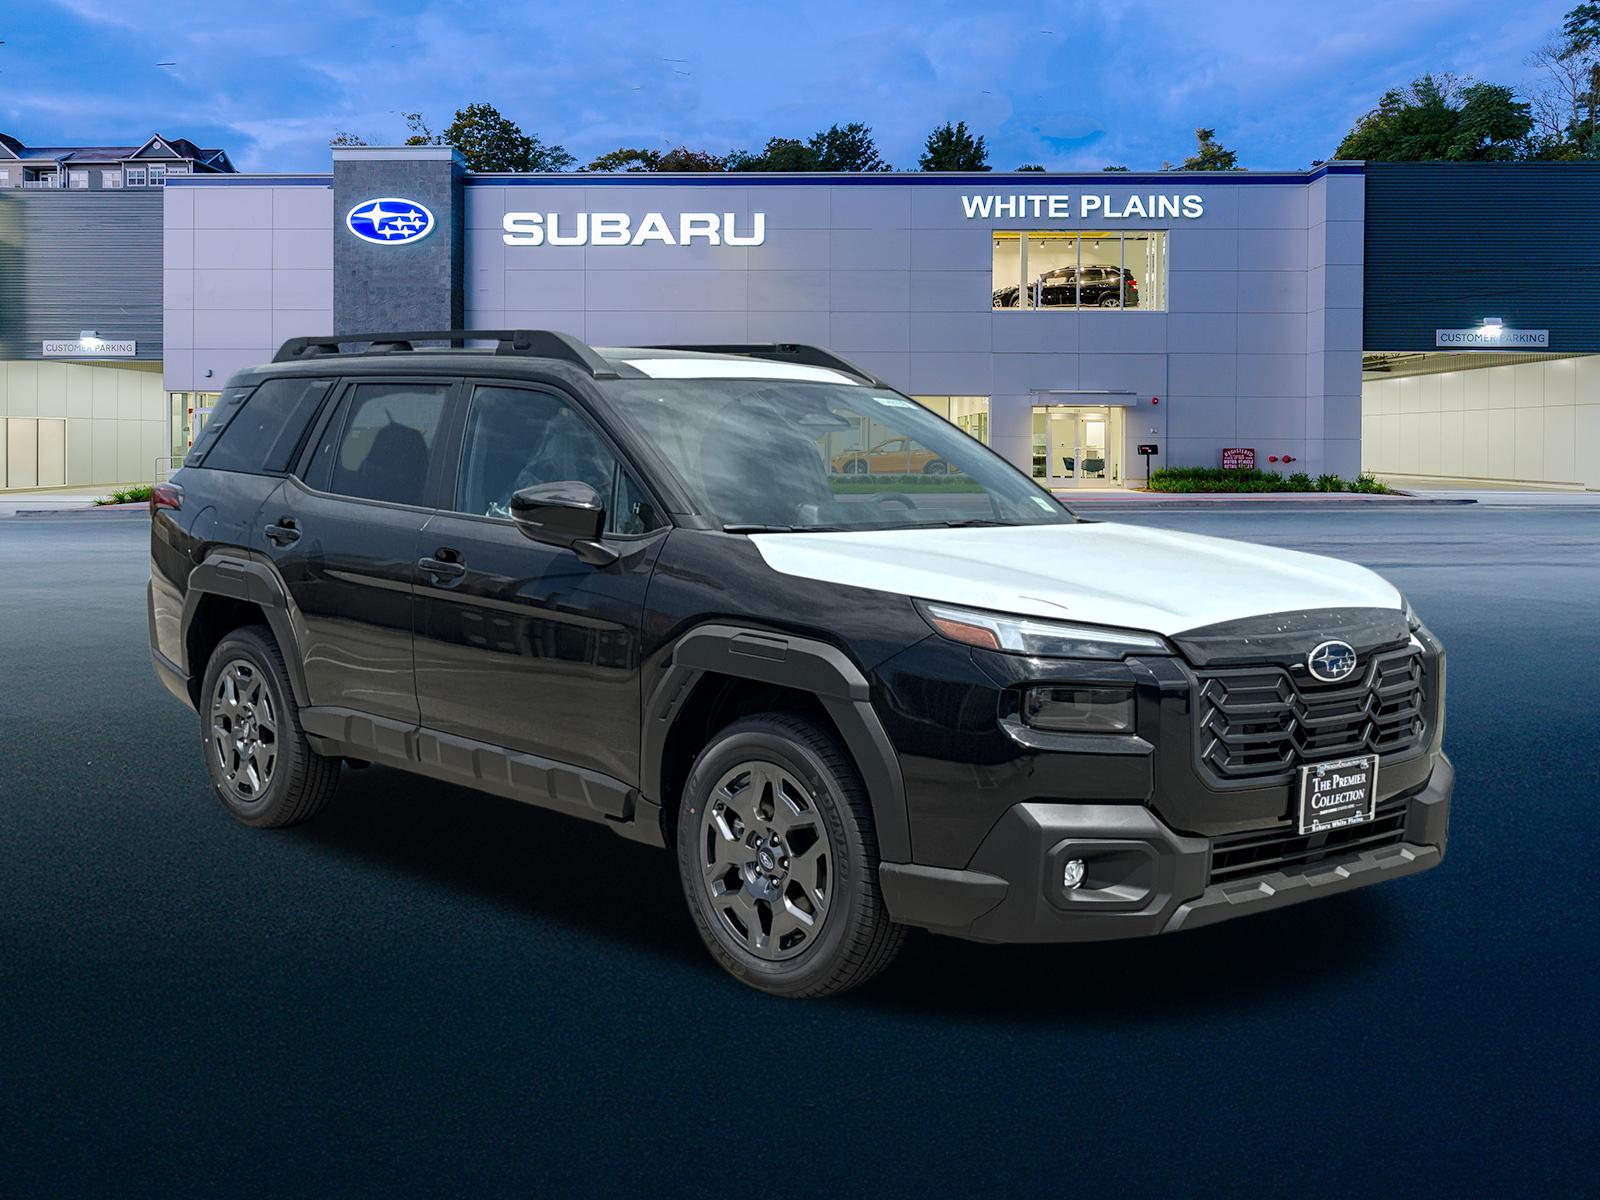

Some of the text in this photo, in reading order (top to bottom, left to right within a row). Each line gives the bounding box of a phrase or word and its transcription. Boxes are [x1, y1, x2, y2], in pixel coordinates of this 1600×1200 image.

[961, 194, 1204, 218] WHITE PLAINS
[502, 212, 766, 246] SUBARU
[1440, 333, 1545, 342] CUSTOMER PARKING
[94, 344, 133, 352] PARKING
[1312, 773, 1367, 793] THE PREMIER
[1311, 788, 1366, 809] COLLECTION
